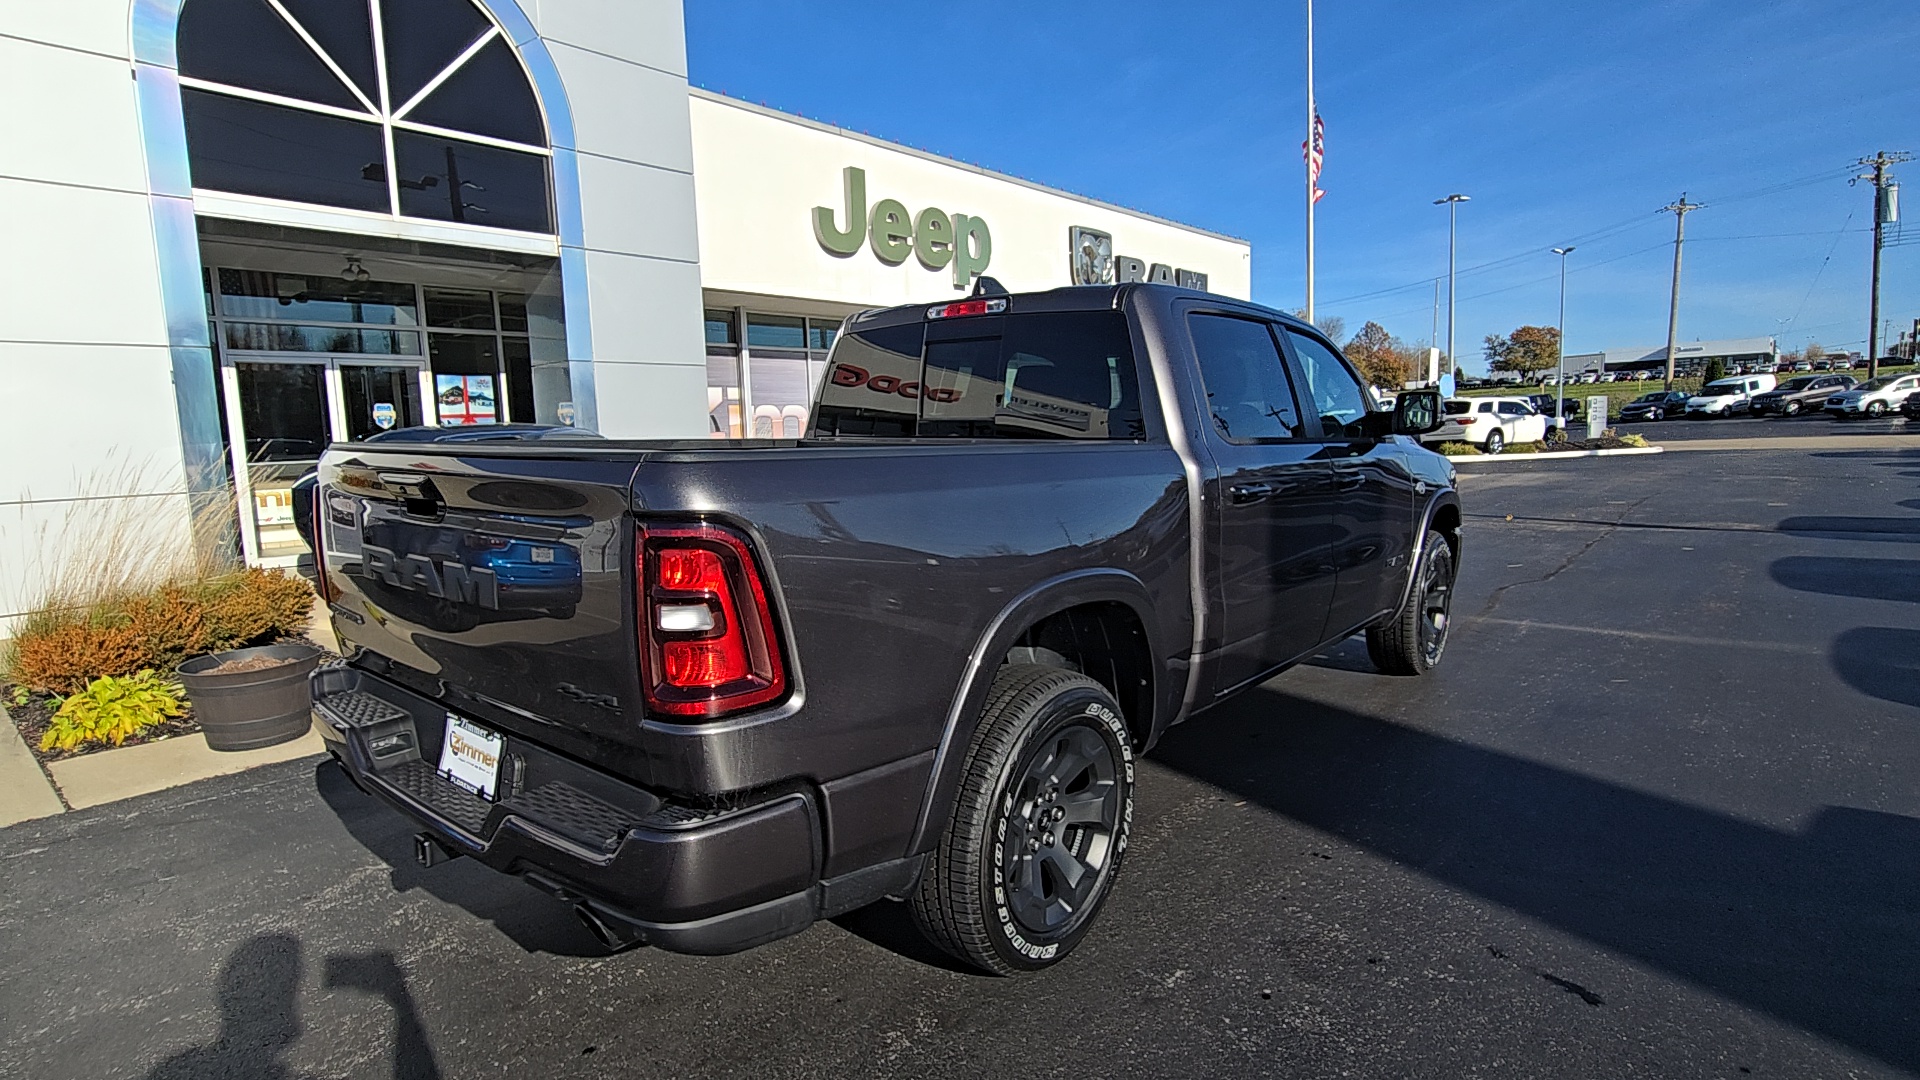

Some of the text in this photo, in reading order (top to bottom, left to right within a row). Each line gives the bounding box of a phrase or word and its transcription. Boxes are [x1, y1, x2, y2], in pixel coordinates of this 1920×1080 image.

[811, 166, 992, 291] Jeep
[1115, 255, 1208, 293] RAM
[361, 544, 499, 610] RAM
[452, 732, 497, 769] Zimmer
[994, 792, 1059, 959] BRIDGESTONE
